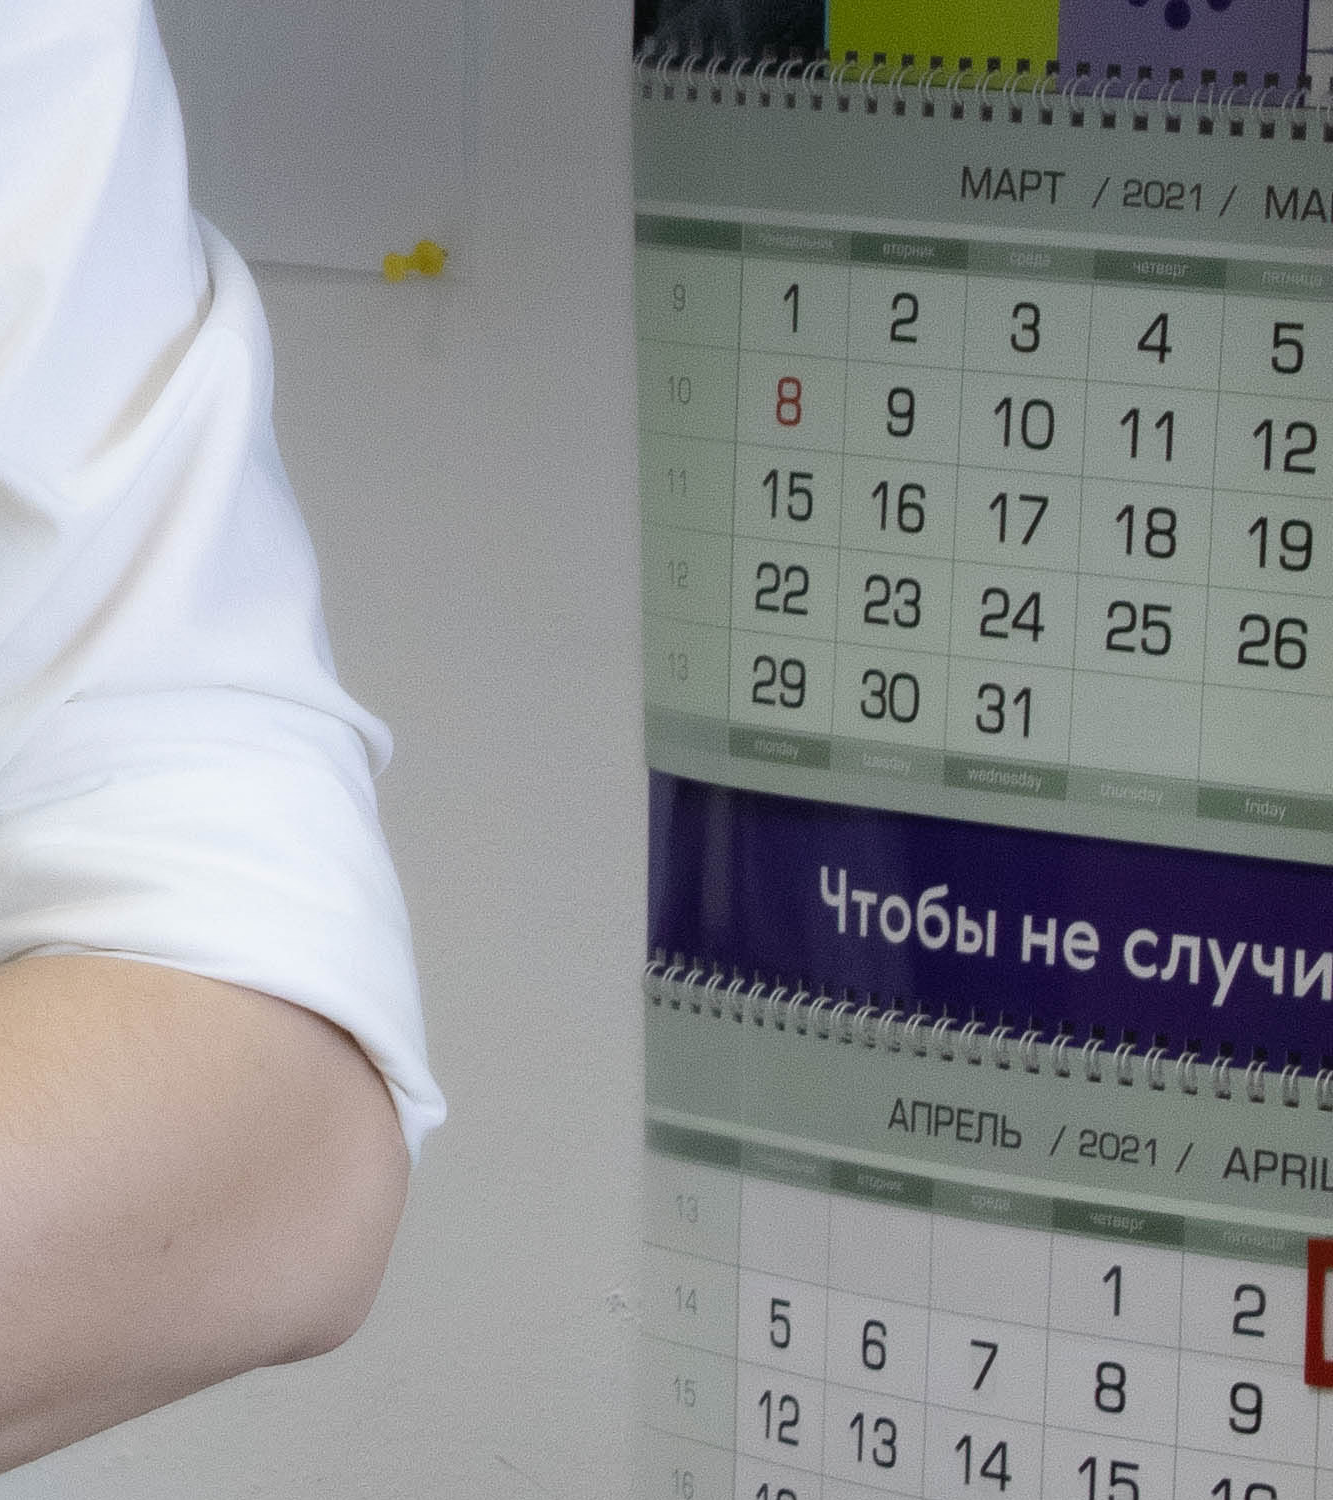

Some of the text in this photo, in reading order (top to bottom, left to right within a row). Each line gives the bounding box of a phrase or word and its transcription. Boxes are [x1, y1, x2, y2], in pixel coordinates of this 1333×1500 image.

[962, 166, 1065, 204] МАРТ
[1123, 179, 1201, 211] 2021
[1133, 259, 1189, 282] четверг
[784, 284, 799, 332] 1
[891, 293, 918, 343] 2
[1011, 302, 1040, 353] 3
[1138, 313, 1171, 363] 4
[1272, 322, 1303, 374] 5
[776, 377, 801, 426] 8
[887, 387, 915, 437] 9
[995, 397, 1054, 450] 10
[1121, 408, 1173, 461] 11
[1254, 420, 1317, 474] 12
[763, 470, 813, 521] 15
[873, 481, 925, 533] 16
[990, 493, 1048, 545] 17
[1117, 505, 1176, 559] 18
[1249, 517, 1313, 571] 19
[756, 562, 809, 615] 22
[864, 575, 921, 628] 23
[981, 588, 1044, 641] 24
[1107, 601, 1171, 655] 25
[1238, 614, 1307, 670] 26
[753, 656, 805, 708] 29
[861, 669, 919, 723] 30
[976, 683, 1031, 737] 31
[967, 766, 1043, 793] wednesday
[1244, 797, 1288, 821] friday
[819, 865, 997, 957] Чтобы
[1022, 913, 1100, 971] не
[888, 1098, 1021, 1149] АПРЕЛЬ
[1079, 1129, 1156, 1165] 2021
[1104, 1266, 1265, 1337] 1 2
[771, 1298, 790, 1349] 5
[862, 1320, 886, 1370] 6
[971, 1340, 998, 1390] 7
[1095, 1362, 1126, 1413] 8
[1230, 1383, 1262, 1434] 9
[759, 1391, 799, 1446] 12
[850, 1413, 896, 1468] 13
[956, 1435, 1011, 1491] 14
